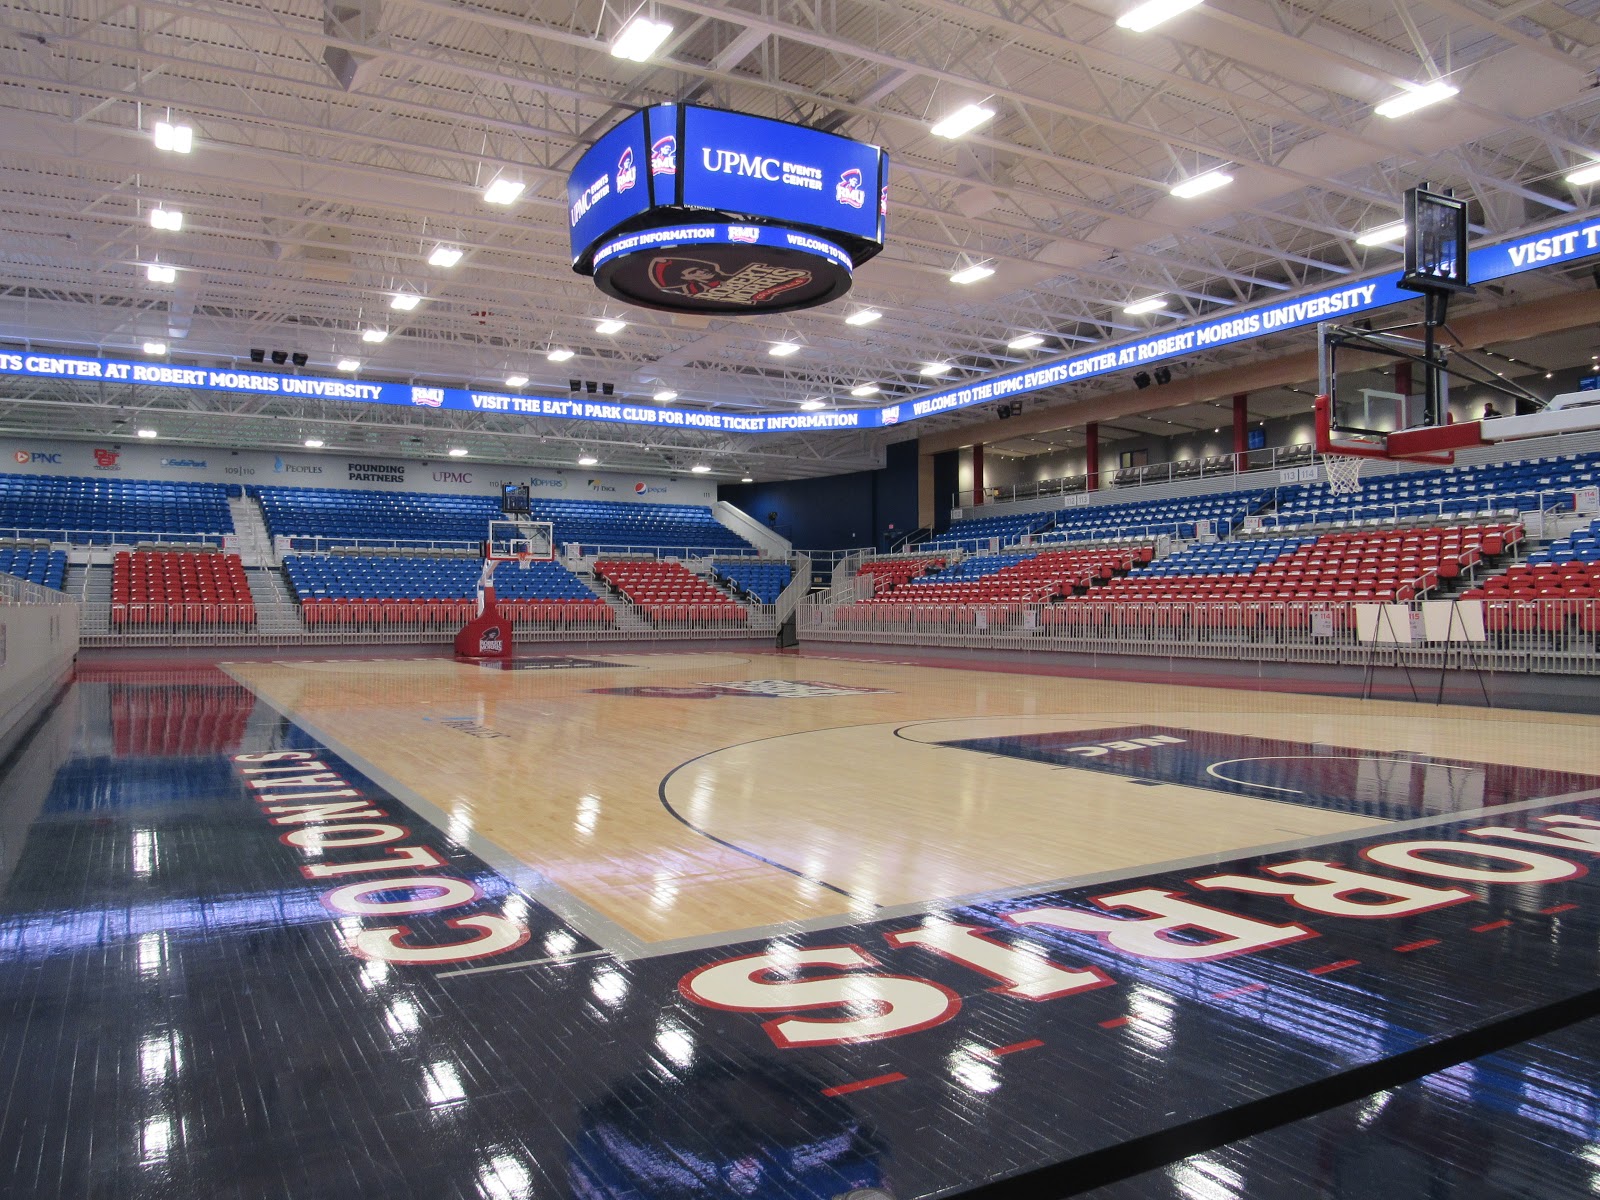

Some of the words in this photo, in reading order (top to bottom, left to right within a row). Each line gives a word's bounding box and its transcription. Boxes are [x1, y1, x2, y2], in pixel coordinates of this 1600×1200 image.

[702, 147, 780, 181] UPMC
[782, 161, 822, 179] EVENTS
[591, 174, 609, 194] EVENTS
[782, 174, 823, 190] CENTER
[591, 185, 610, 205] CENTER
[571, 189, 592, 227] UPMC
[613, 236, 639, 252] TICKET
[640, 228, 715, 245] INFORMATION
[787, 234, 829, 254] WELCOME
[829, 246, 838, 258] TO
[1508, 231, 1579, 267] VISIT
[913, 394, 957, 416] WELCOME
[957, 391, 971, 405] TO
[972, 382, 992, 400] THE
[993, 375, 1023, 396] UPMC
[1024, 364, 1068, 389] EVENTS
[1069, 352, 1116, 378] CENTER
[1118, 346, 1137, 366] AT
[1138, 331, 1194, 361] ROBERT
[1197, 315, 1260, 346] MORRIS
[1263, 284, 1376, 329] UNIVERSITY
[25, 357, 102, 377] CENTER
[105, 363, 131, 379] AT
[133, 366, 207, 385] ROBERT
[209, 372, 279, 391] MORRIS
[282, 378, 382, 400] UNIVERSITY
[471, 394, 511, 410] VISIT
[511, 398, 541, 412] THE
[543, 401, 583, 416] EAT'N
[585, 403, 622, 419] PARK
[623, 407, 656, 422] CLUB
[658, 410, 684, 425] FOR
[685, 413, 721, 428] MORE
[722, 416, 765, 430] TICKET
[767, 413, 858, 430] INFORMATION
[31, 452, 62, 464] PNC
[285, 464, 322, 473] PEOPLES
[348, 463, 405, 474] FOUNDING
[349, 472, 404, 483] PARTNERS
[432, 471, 472, 484] UPMC
[1283, 471, 1295, 480] 113
[1302, 469, 1314, 479] 114
[647, 486, 667, 494] pepsi
[231, 750, 532, 966] COLONIALS
